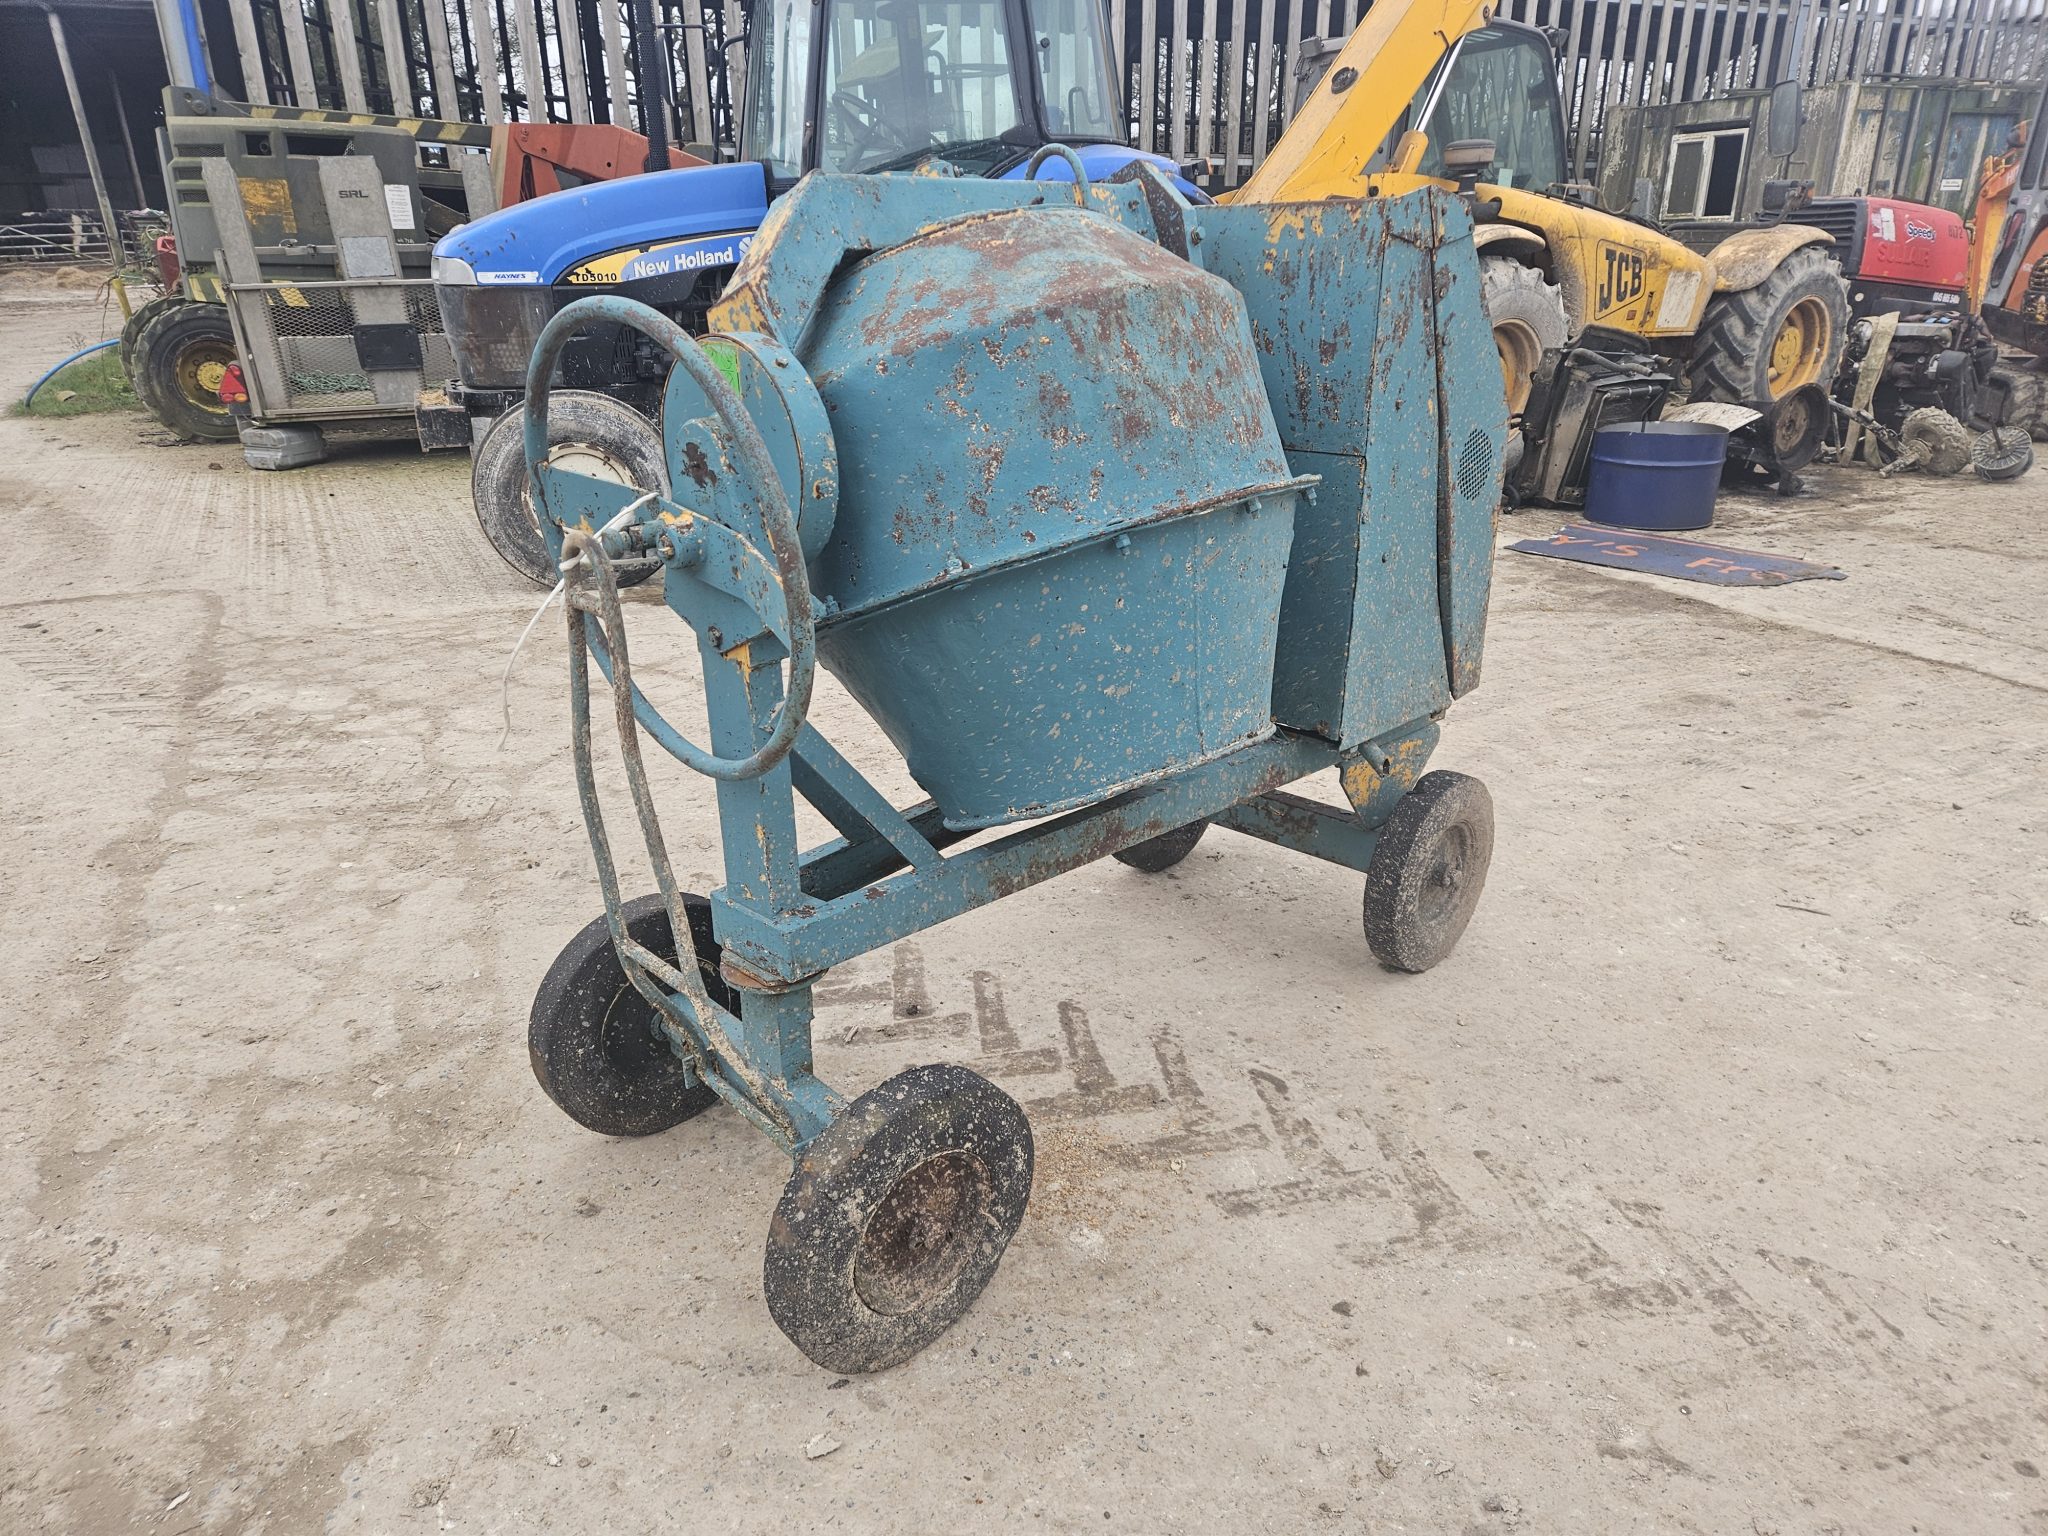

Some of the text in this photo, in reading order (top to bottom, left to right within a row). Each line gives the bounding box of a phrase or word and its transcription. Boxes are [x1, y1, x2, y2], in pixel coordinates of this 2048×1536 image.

[338, 189, 369, 199] SRL
[1906, 221, 1937, 241] Speedy
[633, 246, 734, 278] New Holland
[494, 272, 526, 280] HAYNES
[1598, 247, 1643, 313] JCB
